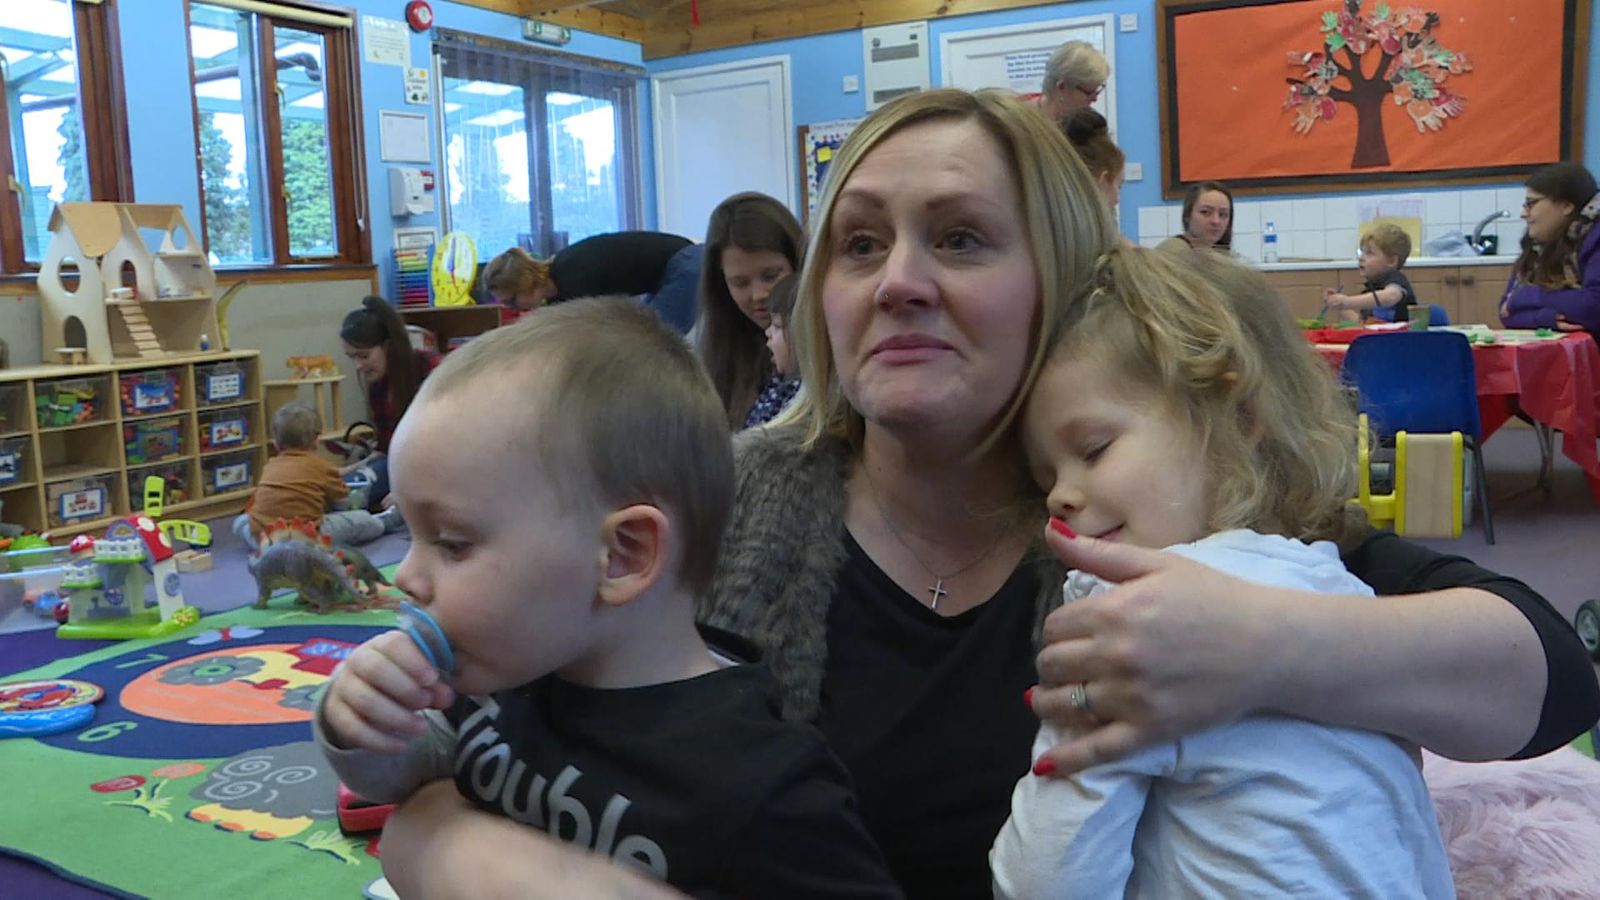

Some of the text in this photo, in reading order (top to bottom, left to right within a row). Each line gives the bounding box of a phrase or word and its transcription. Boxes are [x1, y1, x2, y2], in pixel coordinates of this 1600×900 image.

[114, 653, 169, 669] 7
[77, 721, 138, 742] 6
[454, 696, 668, 882] Trouble
